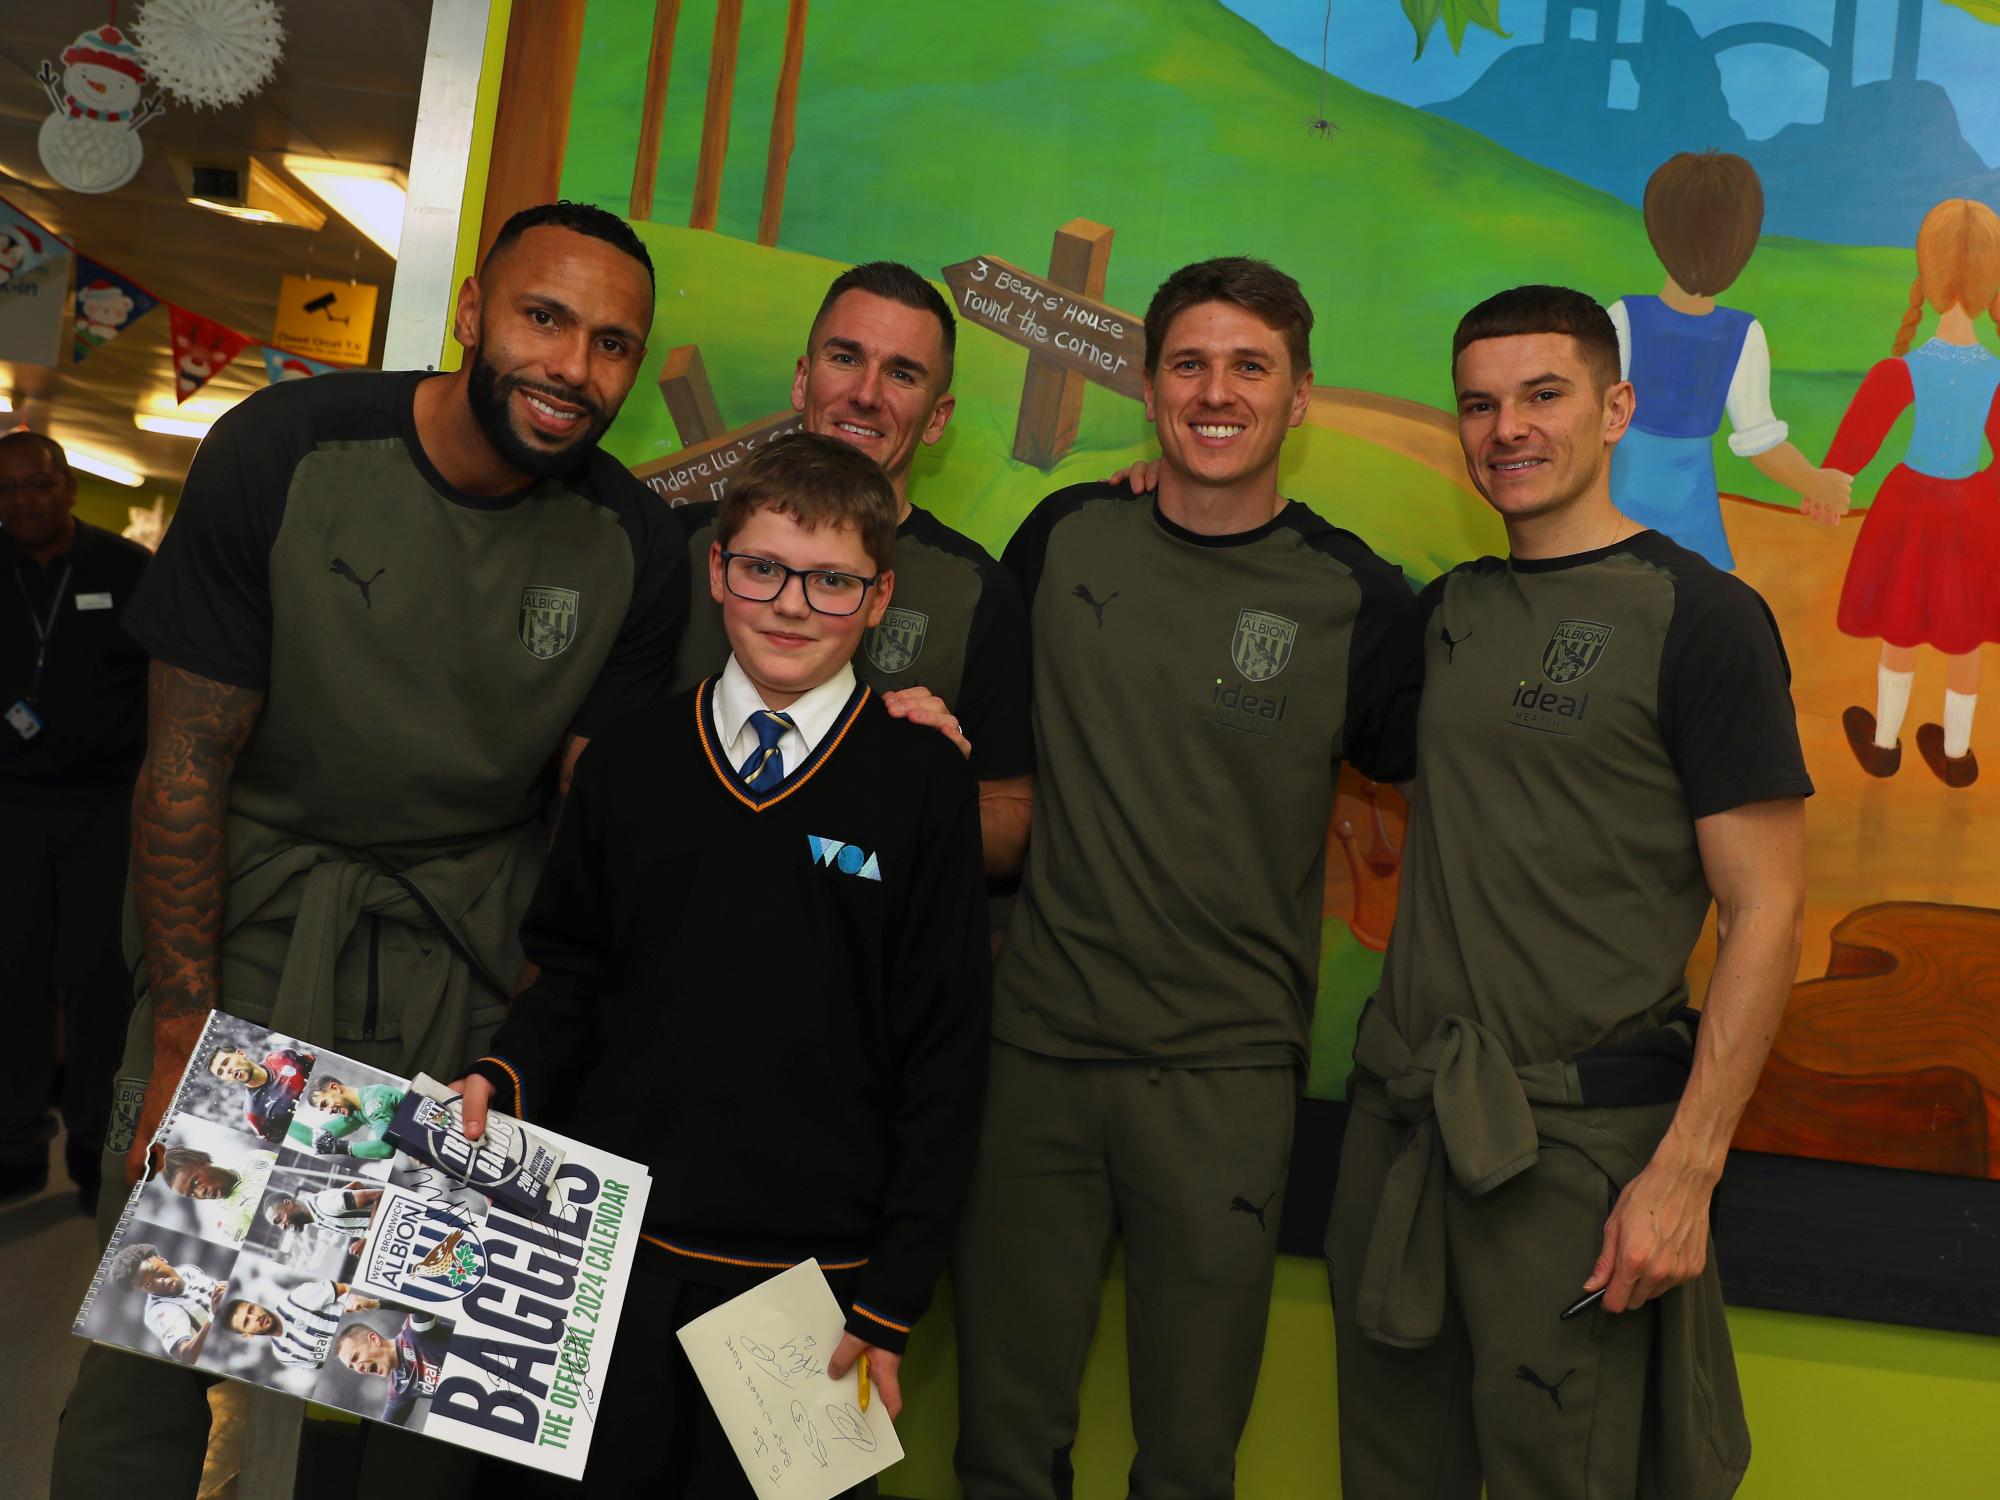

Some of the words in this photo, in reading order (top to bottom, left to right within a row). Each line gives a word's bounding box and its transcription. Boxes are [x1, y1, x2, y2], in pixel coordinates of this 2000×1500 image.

[963, 287, 1014, 325] round
[1017, 309, 1049, 344] the
[971, 259, 990, 282] 3
[1062, 303, 1125, 340] House
[523, 595, 573, 611] ALBION
[884, 616, 923, 632] LBION
[1241, 619, 1290, 641] ALBION
[1555, 628, 1605, 644] ALBION
[1211, 678, 1288, 722] ideal
[1512, 680, 1589, 720] ideal
[1515, 711, 1568, 729] HEATIN
[418, 1100, 434, 1124] ALBION
[476, 1115, 514, 1179] CARDS
[517, 1171, 534, 1192] 200
[371, 1255, 385, 1280] WEST
[381, 1202, 403, 1253] BROMWICH
[585, 1178, 630, 1272] CALENDAR
[382, 1204, 425, 1287] ALBION
[572, 1272, 607, 1324] 2024
[417, 1361, 438, 1395] ideal
[550, 1328, 595, 1410] OFFICIAL
[538, 1409, 575, 1450] THE
[752, 1427, 768, 1458] Joe
[768, 1464, 782, 1488] To
